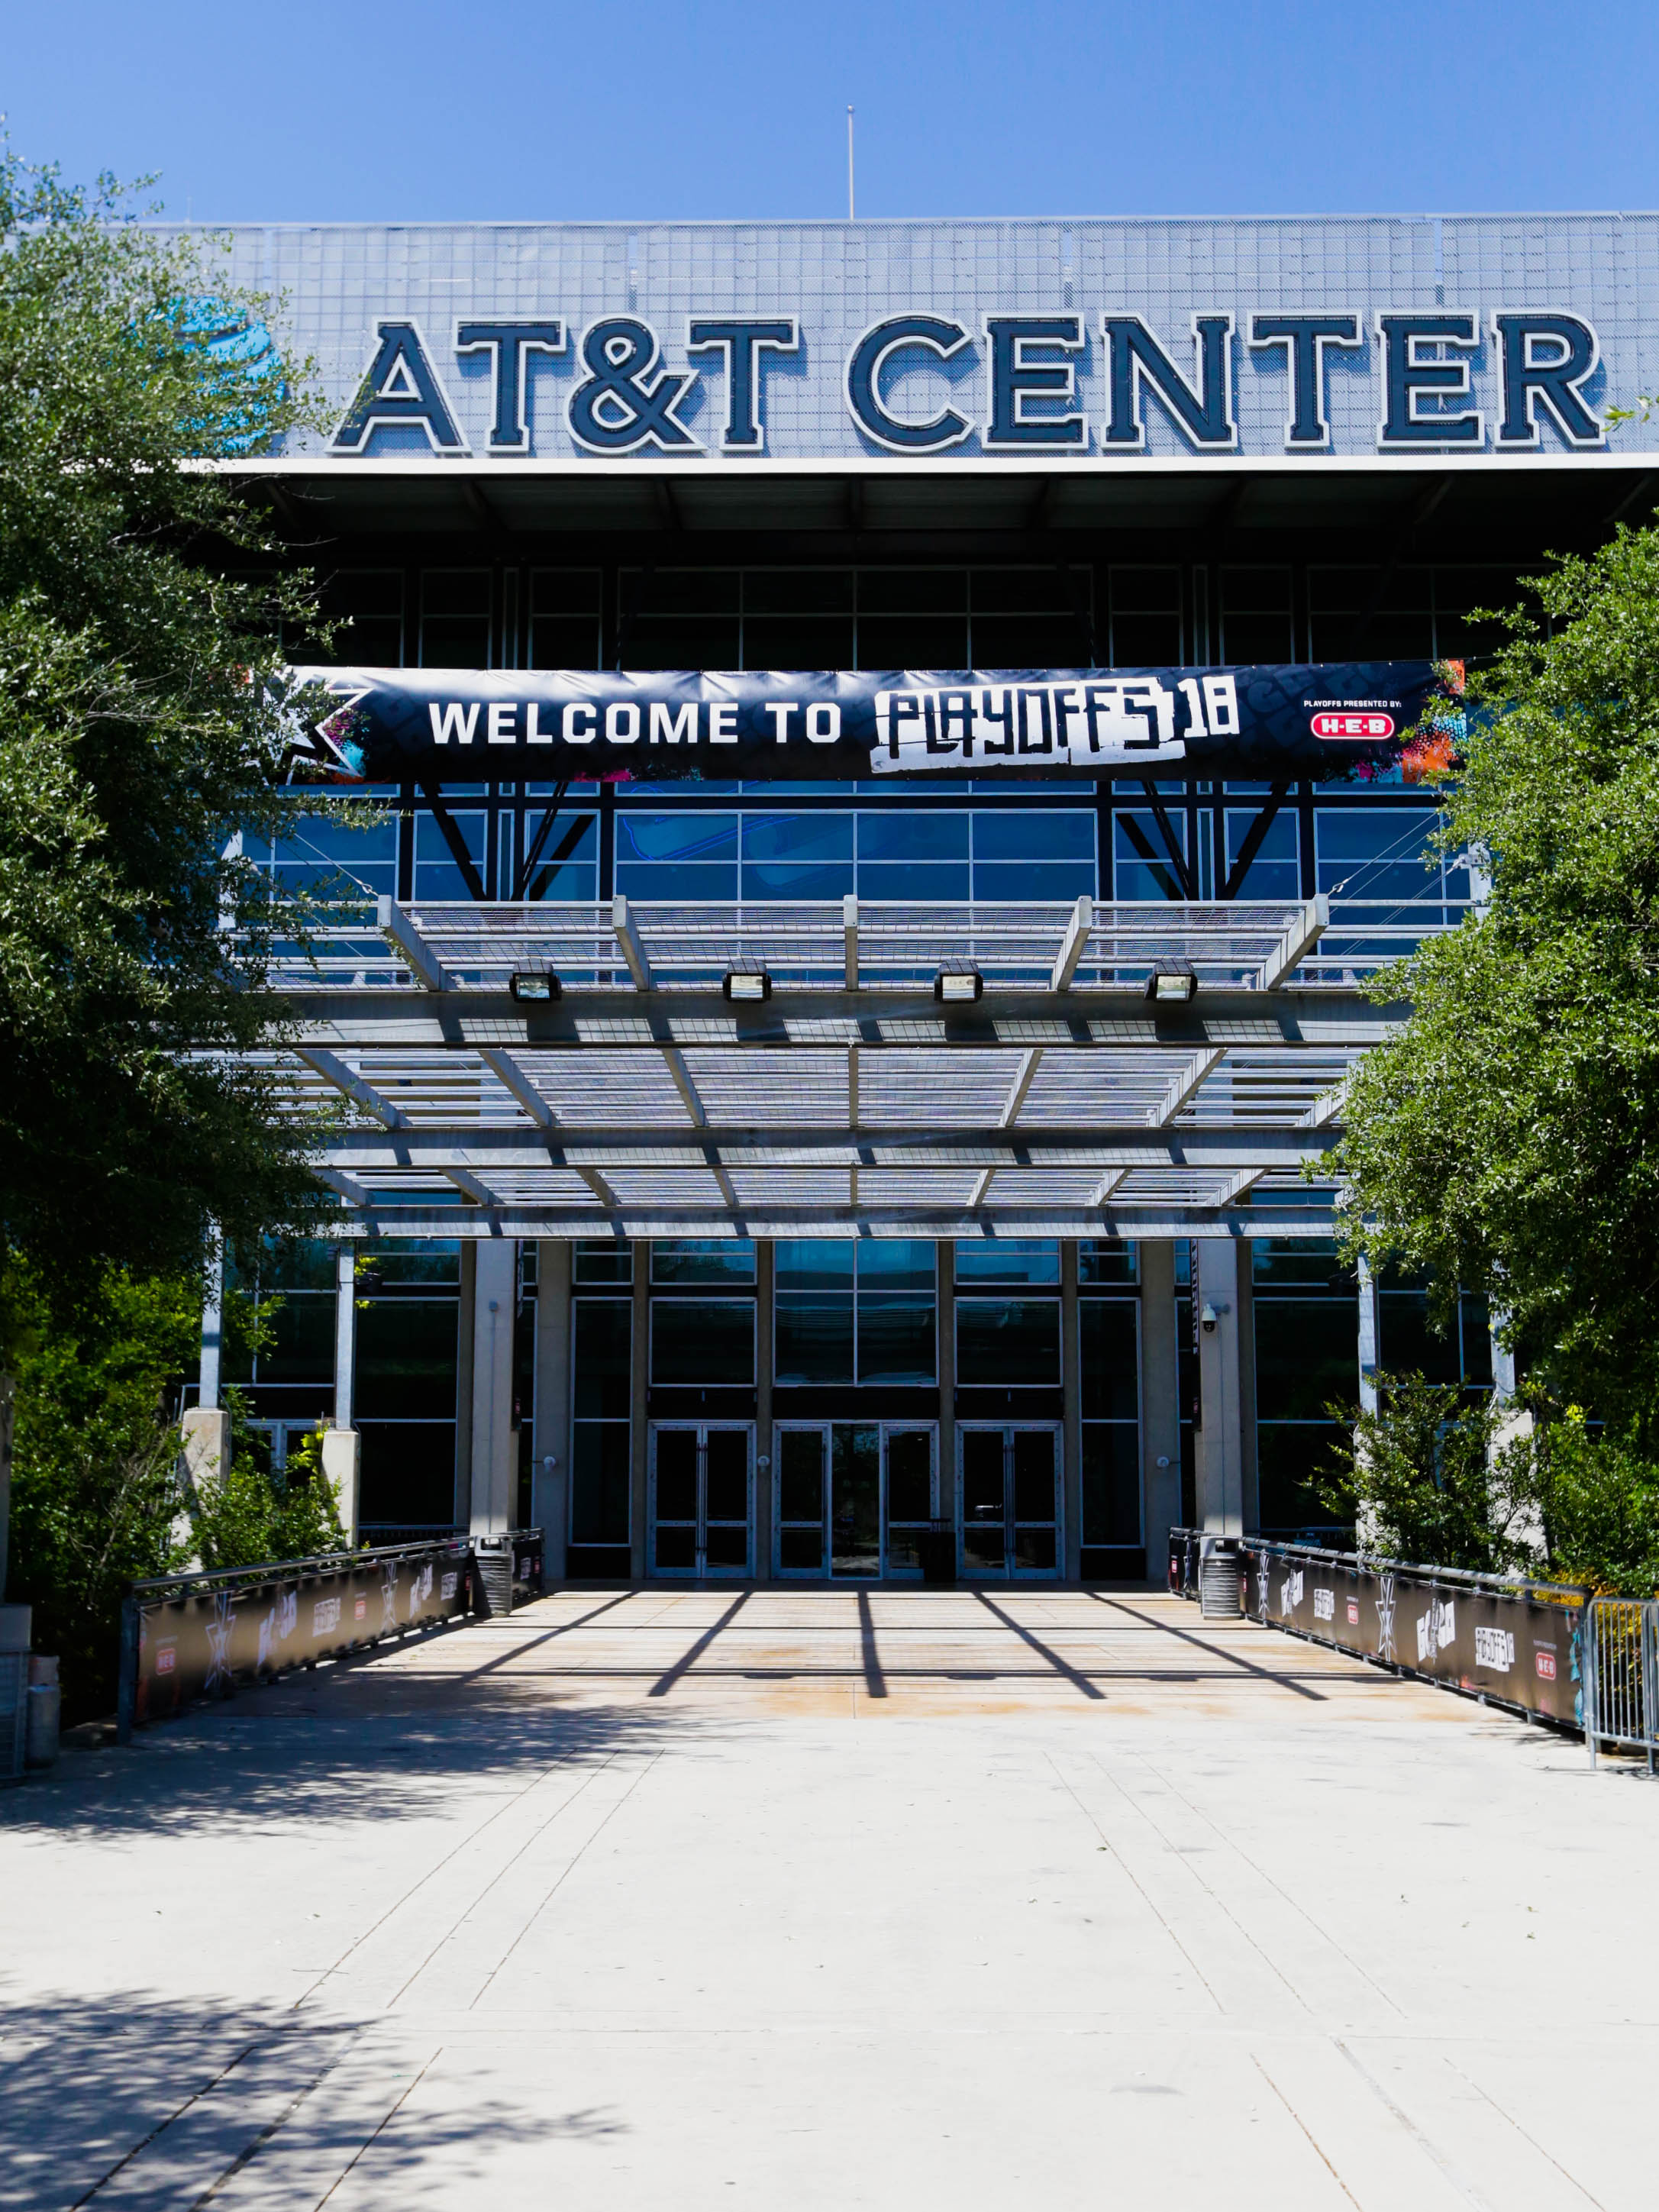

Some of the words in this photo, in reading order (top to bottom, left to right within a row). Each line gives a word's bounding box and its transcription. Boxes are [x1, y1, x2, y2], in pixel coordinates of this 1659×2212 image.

[325, 313, 800, 456] AT&T
[842, 308, 1607, 456] CENTER
[428, 702, 739, 744] WELCOME
[765, 702, 841, 744] TO
[884, 682, 1164, 762] PLAYOFFS
[1178, 675, 1241, 738] 18
[1303, 699, 1342, 708] PLAYOFFS
[1343, 699, 1388, 708] PRESENTED
[1321, 718, 1386, 734] H-E-B
